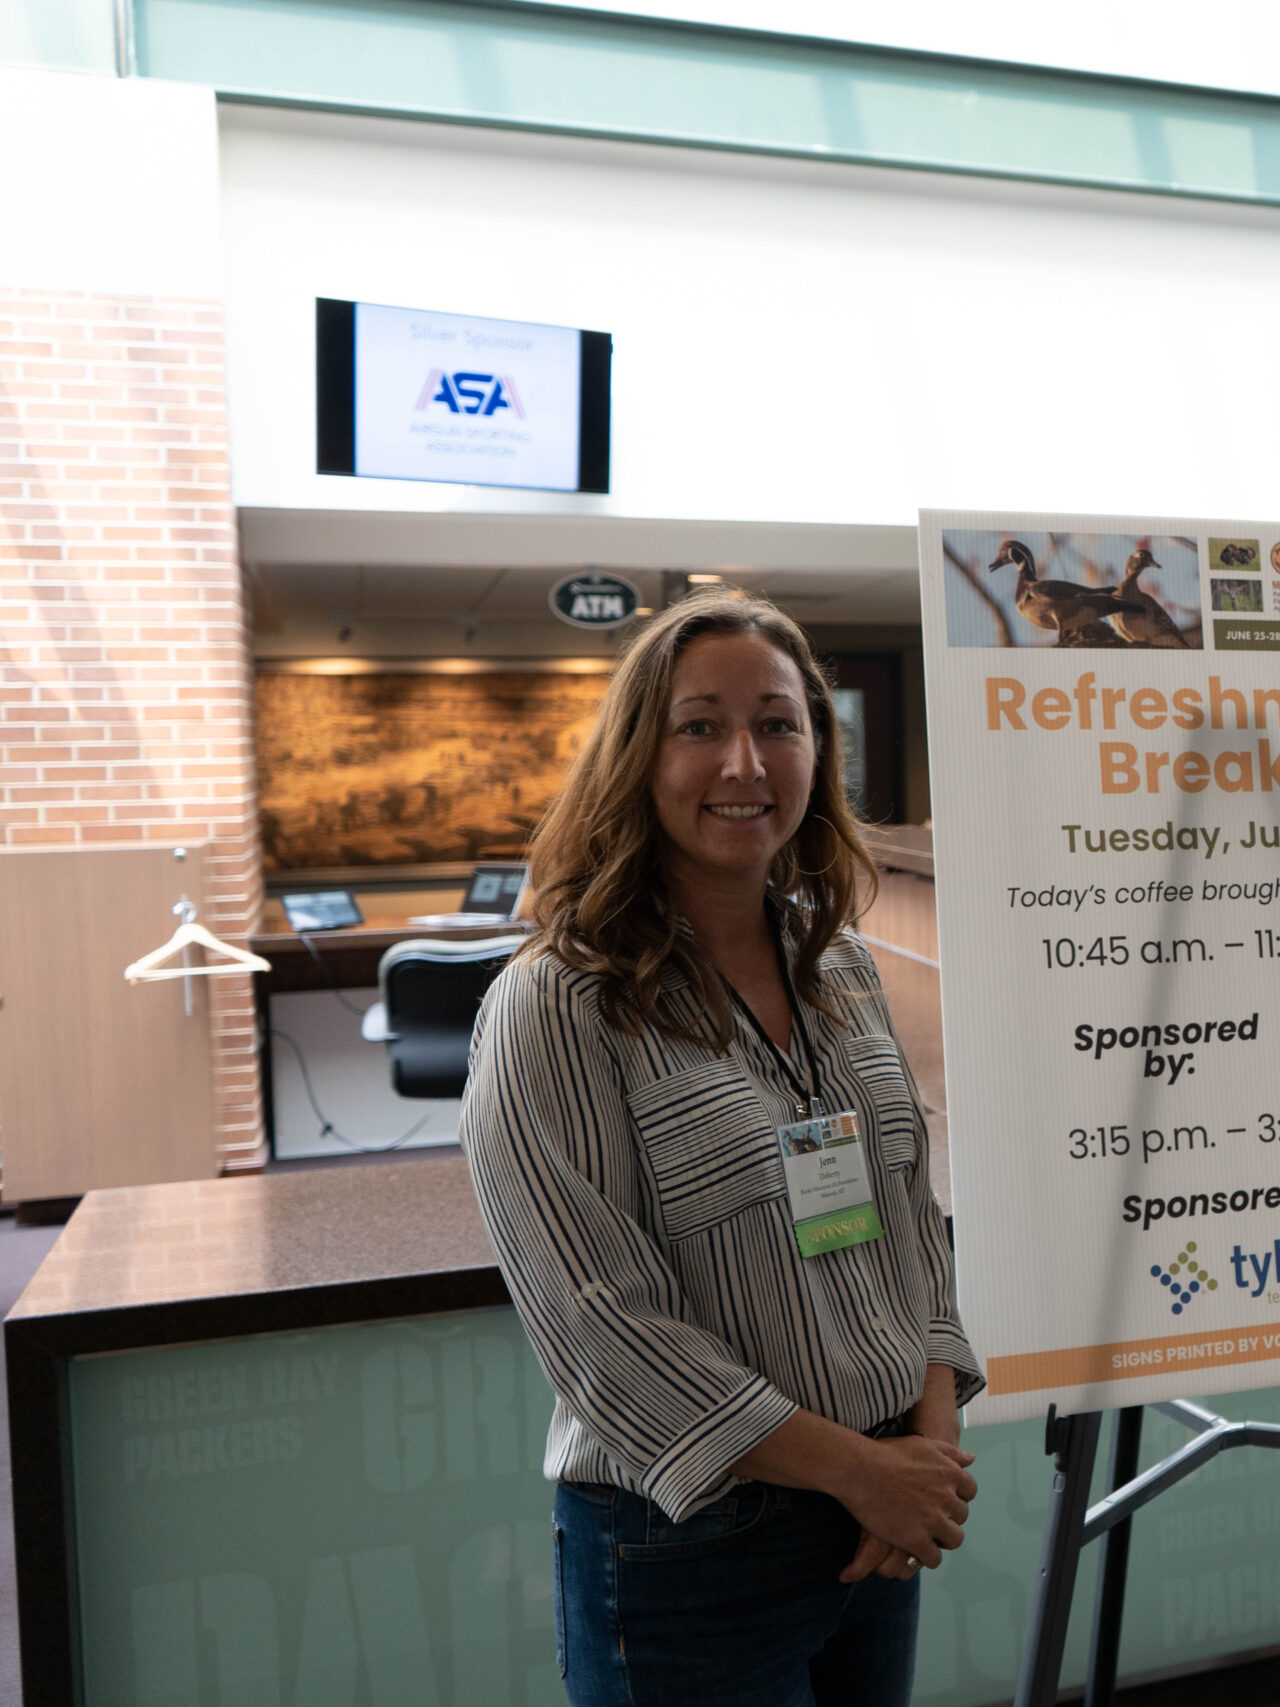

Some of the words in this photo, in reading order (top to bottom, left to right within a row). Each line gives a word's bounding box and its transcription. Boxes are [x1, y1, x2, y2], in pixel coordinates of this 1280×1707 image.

[414, 367, 528, 421] ASA
[571, 595, 624, 618] ATM
[1225, 631, 1250, 641] JUNE
[1061, 821, 1230, 860] Tuesday,
[1114, 881, 1194, 904] coffee
[1042, 935, 1130, 969] 10:45
[1140, 934, 1215, 964] a.m.
[1073, 1013, 1259, 1059] Sponsored
[1143, 1050, 1196, 1085] by:
[1067, 1125, 1131, 1160] 3:15
[1141, 1123, 1216, 1163] p.m.
[818, 1155, 837, 1169] Jenn
[806, 1216, 868, 1244] SPONSOR
[1112, 1346, 1163, 1369] SIGNS
[1167, 1338, 1235, 1363] PRINTED
[1238, 1335, 1260, 1353] BY
[121, 1364, 248, 1424] GREEN
[261, 1353, 342, 1405] BAY
[123, 1415, 304, 1484] PACKERS
